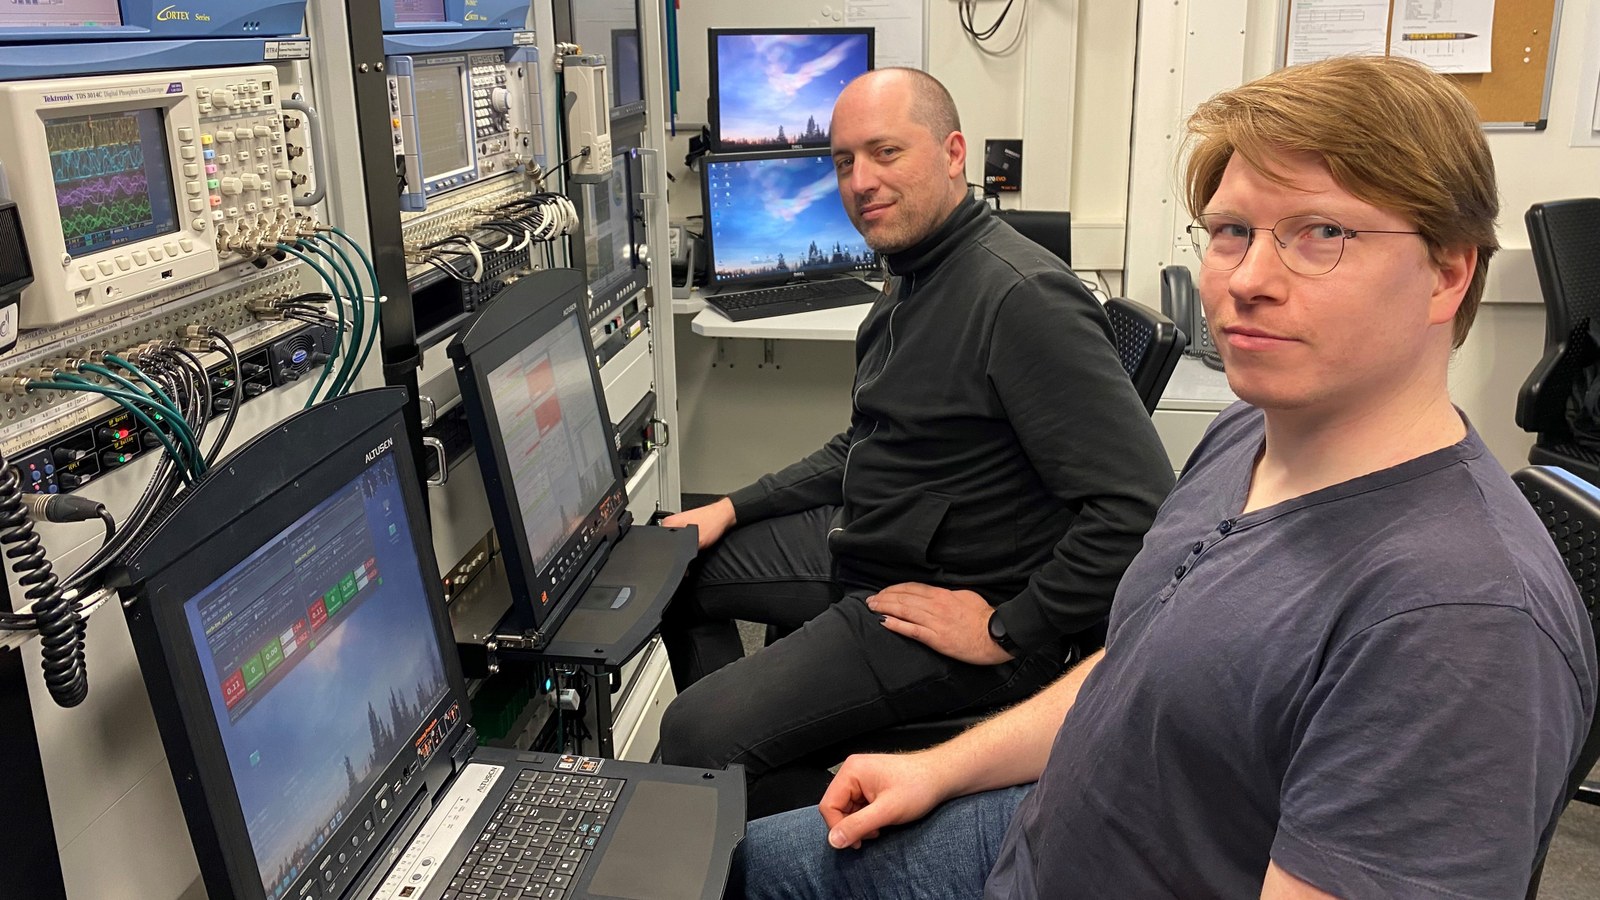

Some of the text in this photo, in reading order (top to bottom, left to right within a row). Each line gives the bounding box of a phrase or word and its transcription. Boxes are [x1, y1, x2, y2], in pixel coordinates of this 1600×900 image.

[157, 5, 190, 21] CORTEX
[43, 94, 74, 103] Tektronix
[365, 437, 393, 464] ALTUSEN
